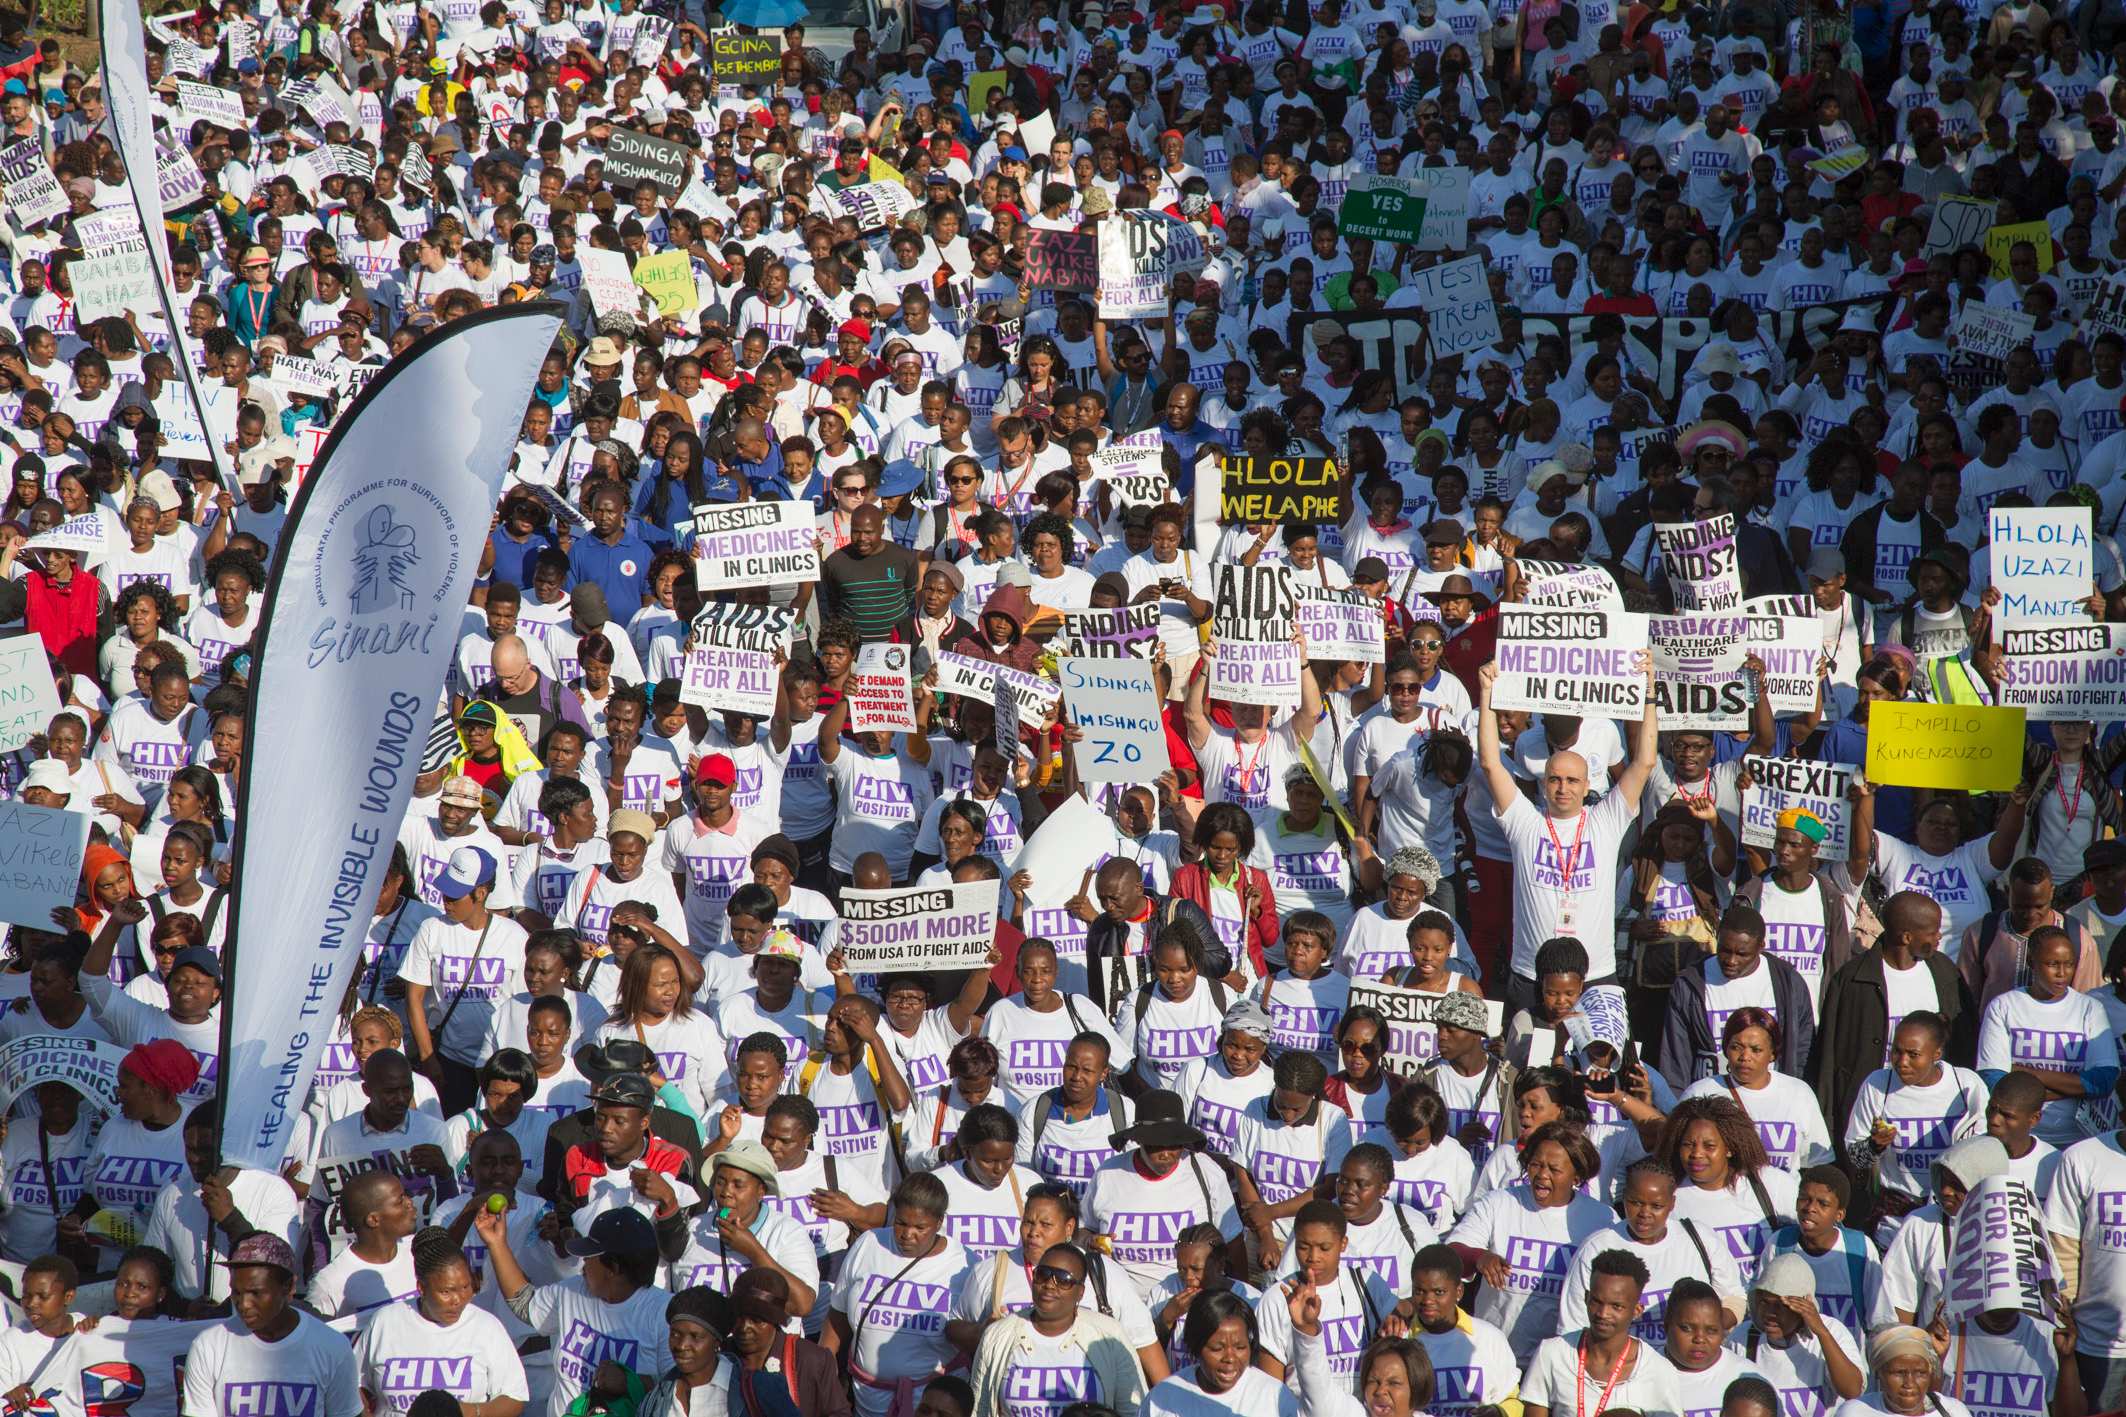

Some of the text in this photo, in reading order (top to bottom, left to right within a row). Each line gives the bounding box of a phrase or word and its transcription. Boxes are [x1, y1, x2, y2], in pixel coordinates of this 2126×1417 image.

[1451, 17, 1478, 28] HIV
[715, 38, 772, 54] GCINA
[1250, 43, 1276, 55] HIV
[1316, 38, 1345, 48] HIV
[1414, 41, 1441, 52] HIV
[179, 84, 222, 98] MISSING
[2053, 86, 2088, 97] HIV
[611, 134, 684, 167] SIDINGA
[1204, 151, 1228, 164] HIV
[1693, 153, 1729, 167] HIV
[0, 153, 46, 187] AIDS?
[1368, 176, 1411, 194] HOSPERSA
[1581, 185, 1612, 199] HIV
[1371, 194, 1402, 212] YES
[1345, 224, 1413, 240] DECENT WORK
[1378, 215, 1388, 225] to
[1134, 257, 1166, 275] KILLS
[1100, 272, 1167, 289] TREATMENT
[1415, 262, 1482, 296] TEST
[1105, 288, 1164, 306] FOR ALL
[1428, 299, 1492, 332] TREAT
[1439, 327, 1496, 352] NOW
[288, 370, 324, 386] THERE
[1101, 452, 1146, 466] SYSTEMS
[387, 478, 408, 488] FOR
[1221, 457, 1339, 487] HLOLA
[329, 481, 385, 527] PROGRAMME
[410, 482, 455, 532] SURVIVORS
[1221, 494, 1339, 522] WELAPHE
[697, 506, 776, 532] MISSING
[1994, 515, 2088, 548] HLOLA
[448, 534, 459, 548] OF
[699, 528, 814, 560] MEDICINES
[1657, 514, 1734, 553] ENDING
[724, 554, 815, 578] IN CLINICS
[1665, 546, 1735, 581] AIDS?
[2004, 555, 2083, 578] UZAZI
[433, 552, 459, 602] VIOLENCE
[1678, 579, 1730, 598] NOT EVEN
[1216, 564, 1294, 620] AIDS
[1295, 583, 1336, 603] STILL
[694, 601, 795, 634] AIDS
[1065, 604, 1160, 638] ENDING
[1214, 616, 1254, 642] STILL
[1502, 615, 1600, 638] MISSING
[1649, 617, 1748, 638] BROKEN
[308, 613, 439, 669] Sinani
[694, 623, 782, 653] STILL KILLS
[1302, 622, 1379, 642] FOR ALL
[1652, 634, 1739, 649] HEALTHCARE
[2007, 630, 2103, 656] MISSING
[1664, 646, 1727, 658] SYSTEMS
[691, 668, 772, 692] FOR ALL
[867, 676, 905, 687] DEMAND
[955, 668, 976, 686] IN
[1066, 660, 1152, 693] SIDINGA
[1217, 663, 1296, 683] FOR ALL
[2005, 658, 2078, 688] $500M
[891, 689, 904, 700] TO
[1525, 677, 1640, 705] IN CLINICS
[1655, 683, 1747, 713] AIDS
[2005, 689, 2116, 705] FROM USA TO FIGHT
[855, 701, 908, 712] TREATMENT
[867, 714, 903, 725] FOR ALL
[1895, 711, 1981, 733] IMPILO
[1092, 741, 1141, 763] ZO
[1876, 743, 1993, 761] KUNENZUZO
[858, 777, 909, 802] HIV
[1751, 759, 1849, 798] BREXIT
[855, 800, 910, 819] POSITIVE
[1759, 785, 1790, 809] THE
[690, 859, 746, 881] HIV
[1277, 853, 1338, 874] HIV
[1276, 874, 1340, 890] POSITIVE
[1905, 865, 1966, 889] HIV
[844, 892, 947, 919] MISSING
[257, 691, 421, 1149] HEALING THE INVISIBLE WOUNDS
[841, 912, 991, 947] $500M MORE
[842, 939, 991, 961] FROM USA TO FIGHT AIDS
[1765, 926, 1822, 952] HIV
[1273, 1007, 1337, 1034] HIV
[1014, 1040, 1070, 1067] HIV
[1152, 1028, 1216, 1056] HIV
[1270, 1033, 1335, 1054] POSITIVE
[2016, 1030, 2084, 1060] HIV
[1890, 1117, 1953, 1151] HIV
[98, 1157, 181, 1187] HIV
[1046, 1148, 1110, 1176] HIV
[1256, 1152, 1320, 1186] HIV
[948, 1217, 1020, 1245] HIV
[1117, 1213, 1193, 1243] HIV
[1511, 1241, 1577, 1271] HIV
[1983, 1191, 2010, 1299] FOR ALL
[2006, 1180, 2041, 1316] TREATMENT
[863, 1276, 949, 1310] HIV
[566, 1320, 636, 1367] HIV
[387, 1359, 466, 1388] HIV
[1012, 1370, 1094, 1399] HIV
[229, 1385, 315, 1417] HIV
[1958, 1375, 2042, 1407] HIV
